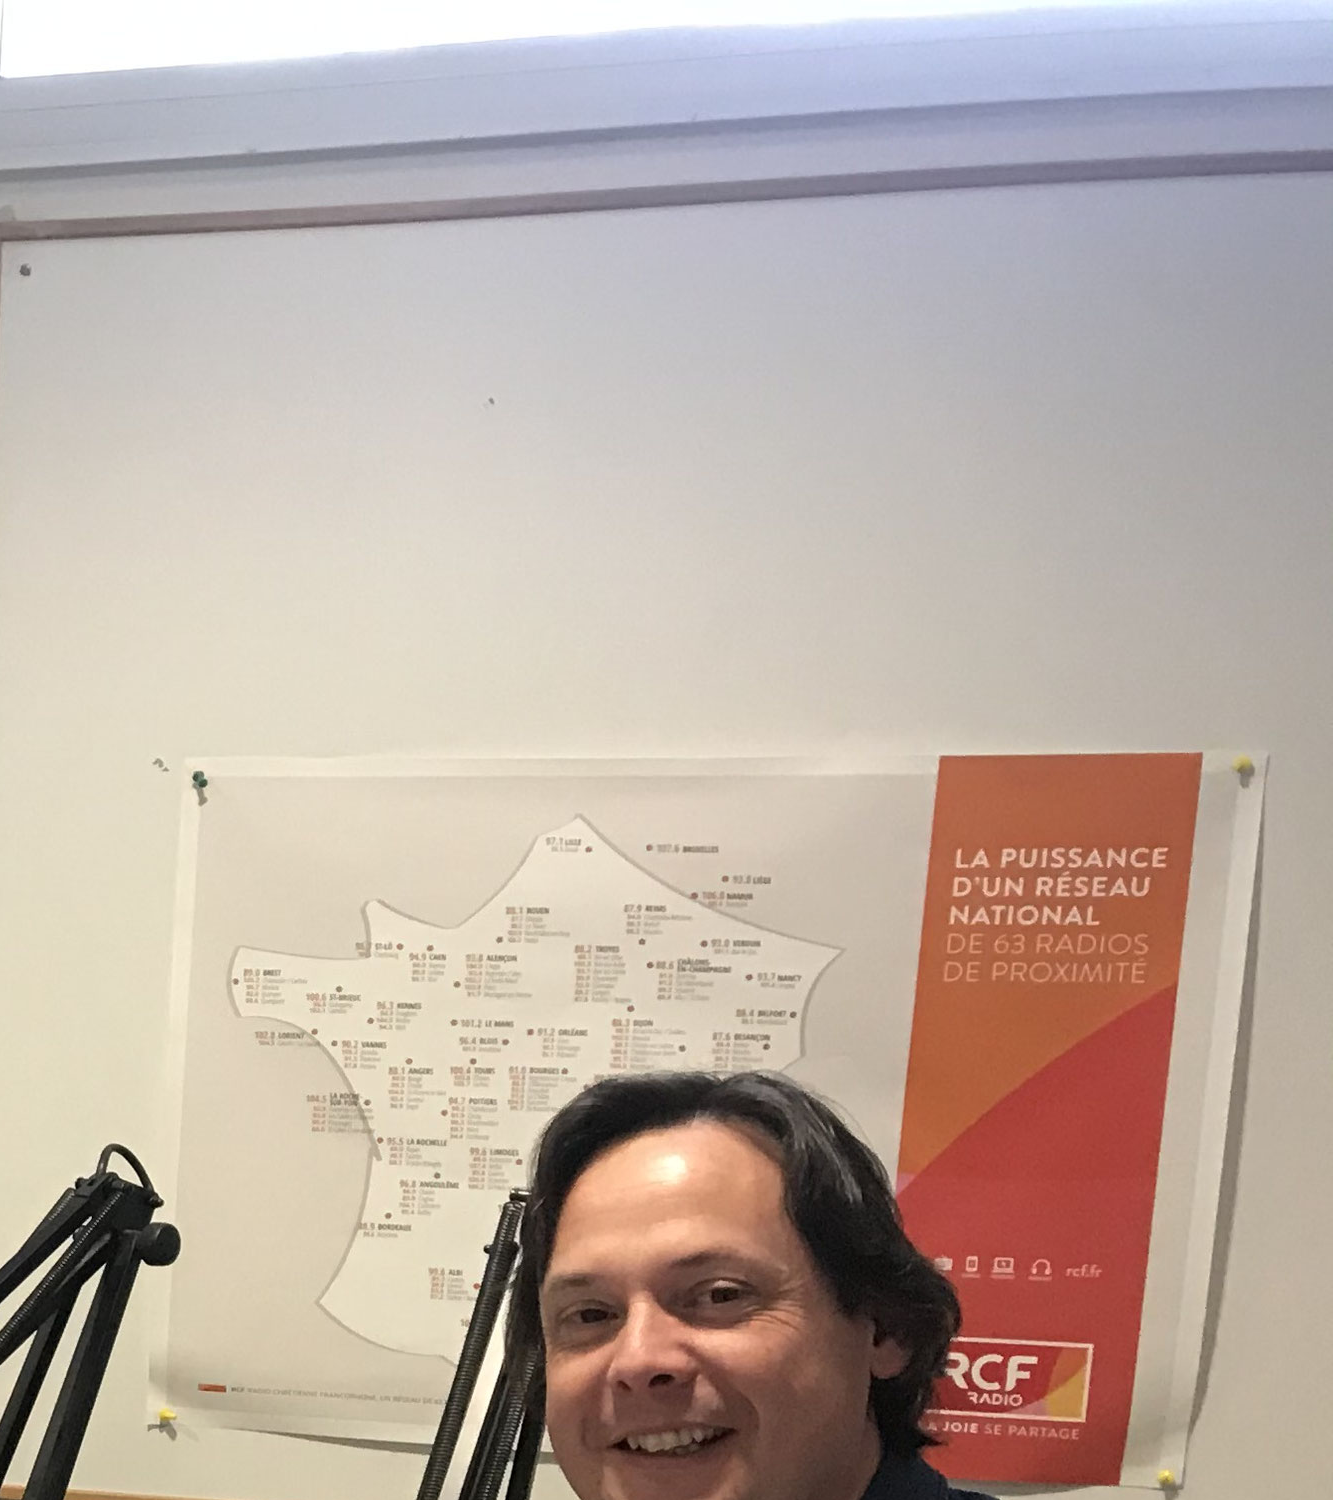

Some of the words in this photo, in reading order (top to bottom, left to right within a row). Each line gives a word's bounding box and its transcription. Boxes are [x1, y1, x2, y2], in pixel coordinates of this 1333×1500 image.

[955, 848, 990, 868] LA
[1000, 847, 1169, 868] PUISSANCE
[952, 876, 1025, 897] D'UN
[1035, 871, 1151, 897] RÉSEAU
[948, 905, 1101, 926] NATIONAL
[946, 933, 984, 954] DE
[994, 933, 1026, 954] 63
[1035, 933, 1149, 955] RADIOS
[943, 961, 982, 982] DE
[992, 958, 1148, 983] PROXIMITÉ
[1065, 1264, 1102, 1278] rcf.fr
[945, 1352, 1038, 1392] RCF
[967, 1391, 1023, 1407] RADIO
[942, 1422, 980, 1433] JOIE
[984, 1424, 1002, 1435] SE
[1008, 1426, 1080, 1440] PARTAGE
